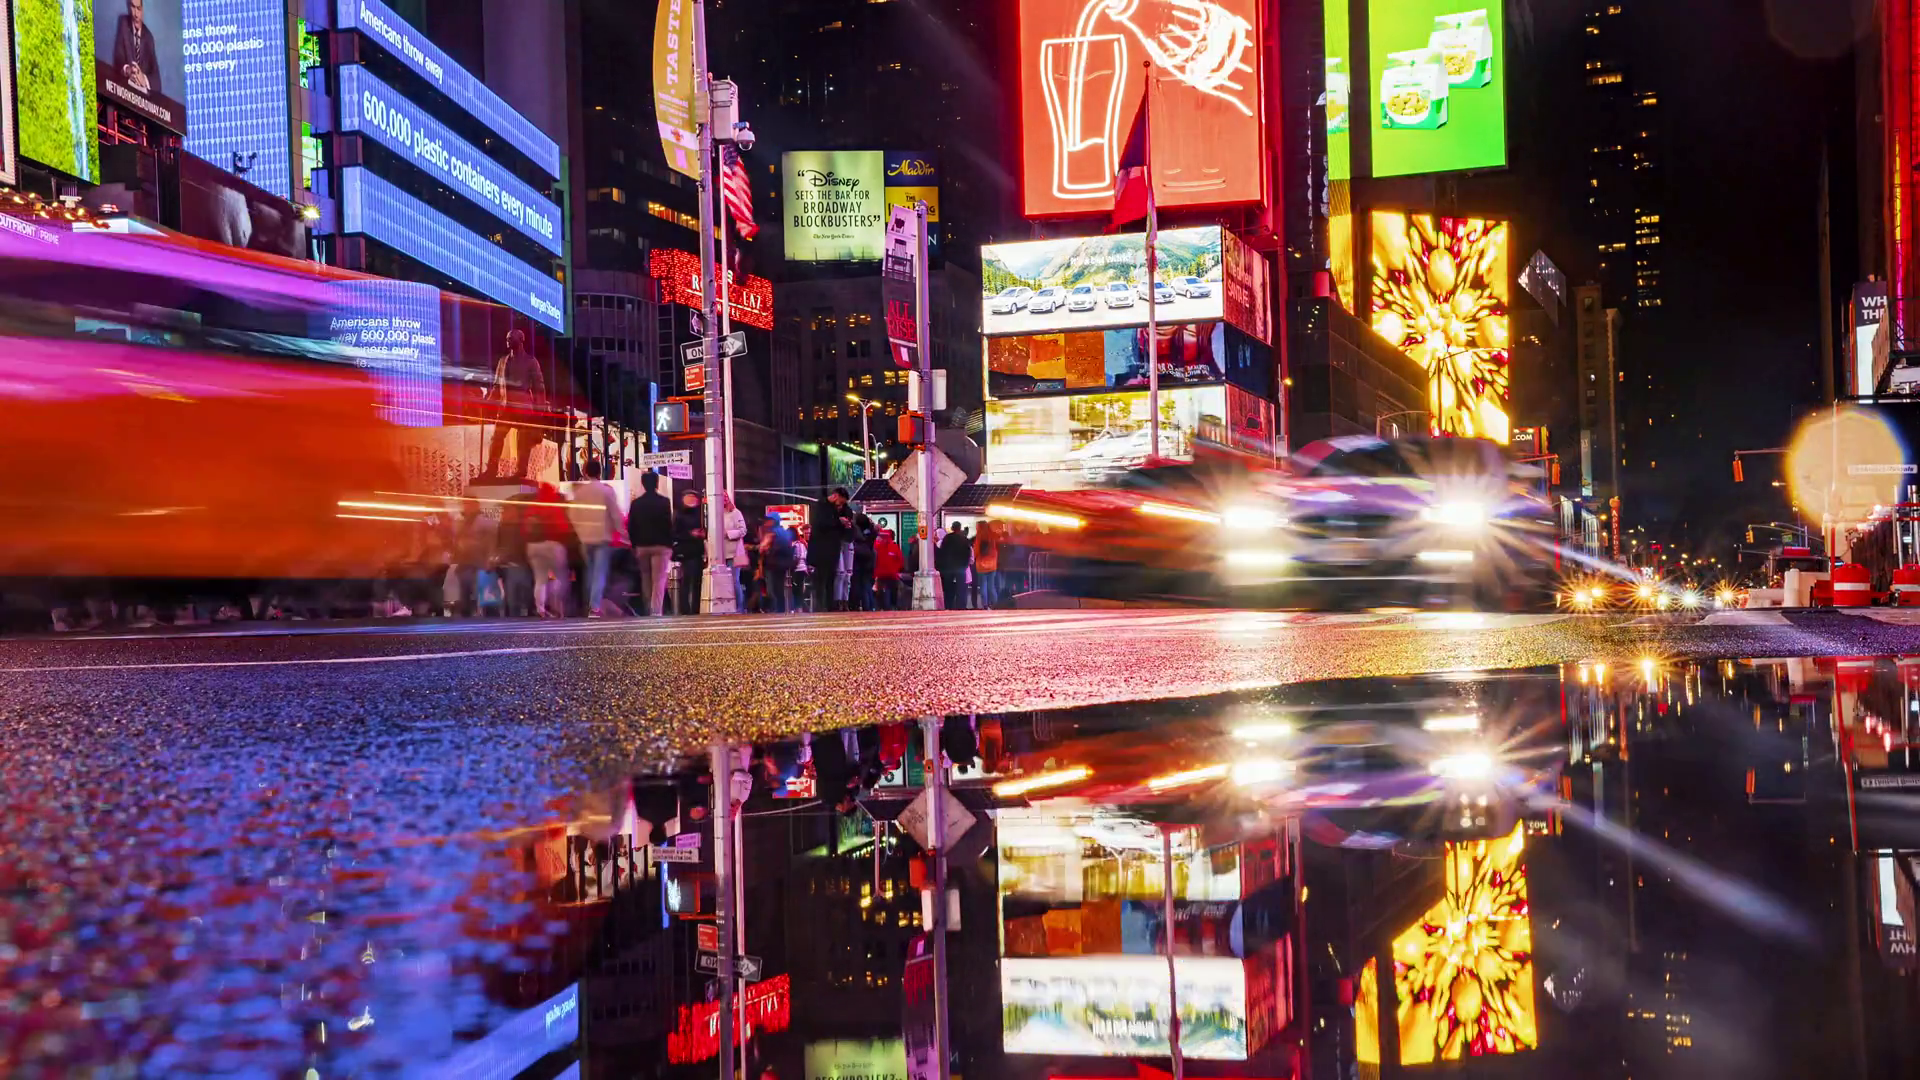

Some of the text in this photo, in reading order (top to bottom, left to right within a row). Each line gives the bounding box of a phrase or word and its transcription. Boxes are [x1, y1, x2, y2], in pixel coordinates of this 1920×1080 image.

[205, 23, 238, 37] throw
[226, 36, 264, 55] plastic
[360, 0, 443, 85] Americans throw away
[205, 59, 236, 72] every
[105, 79, 172, 123] NETWORKBROADWAY.COM
[363, 90, 553, 239] 600,000 plastic containers every minute
[887, 159, 935, 176] Aladdin
[795, 190, 870, 200] SETS THE BAR FOR
[803, 201, 862, 214] BROADWAY
[331, 316, 421, 330] Americans throw
[361, 329, 410, 344] 600,000
